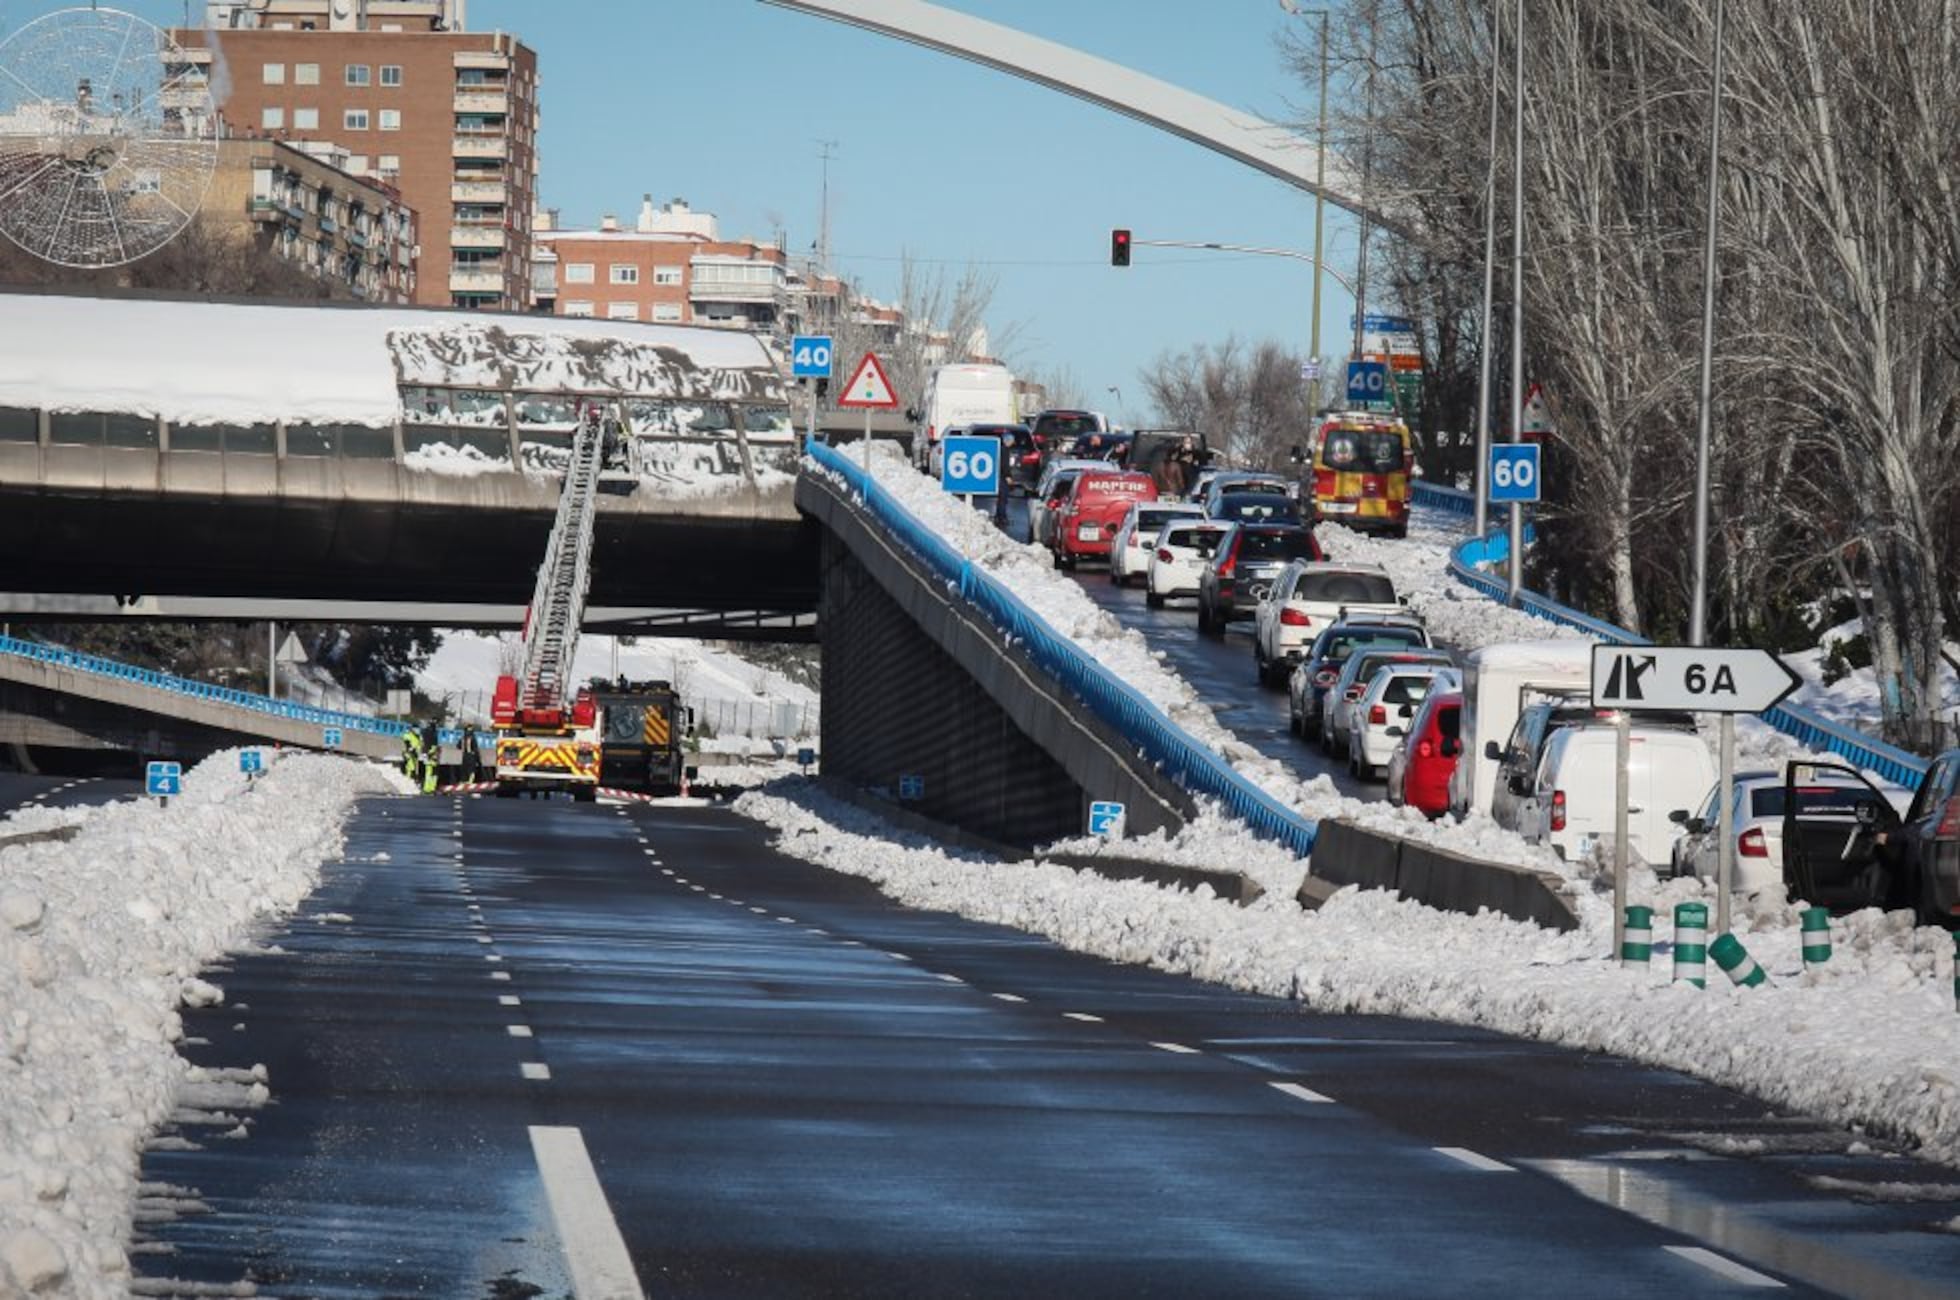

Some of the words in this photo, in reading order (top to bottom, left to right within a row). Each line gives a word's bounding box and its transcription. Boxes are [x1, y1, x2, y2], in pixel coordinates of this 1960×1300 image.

[795, 347, 829, 367] 40
[1349, 371, 1383, 391] 40
[948, 451, 993, 480] 60
[1495, 459, 1533, 487] 60
[1088, 481, 1147, 492] MAPFRE
[1685, 664, 1737, 695] 6A
[157, 777, 171, 792] 4
